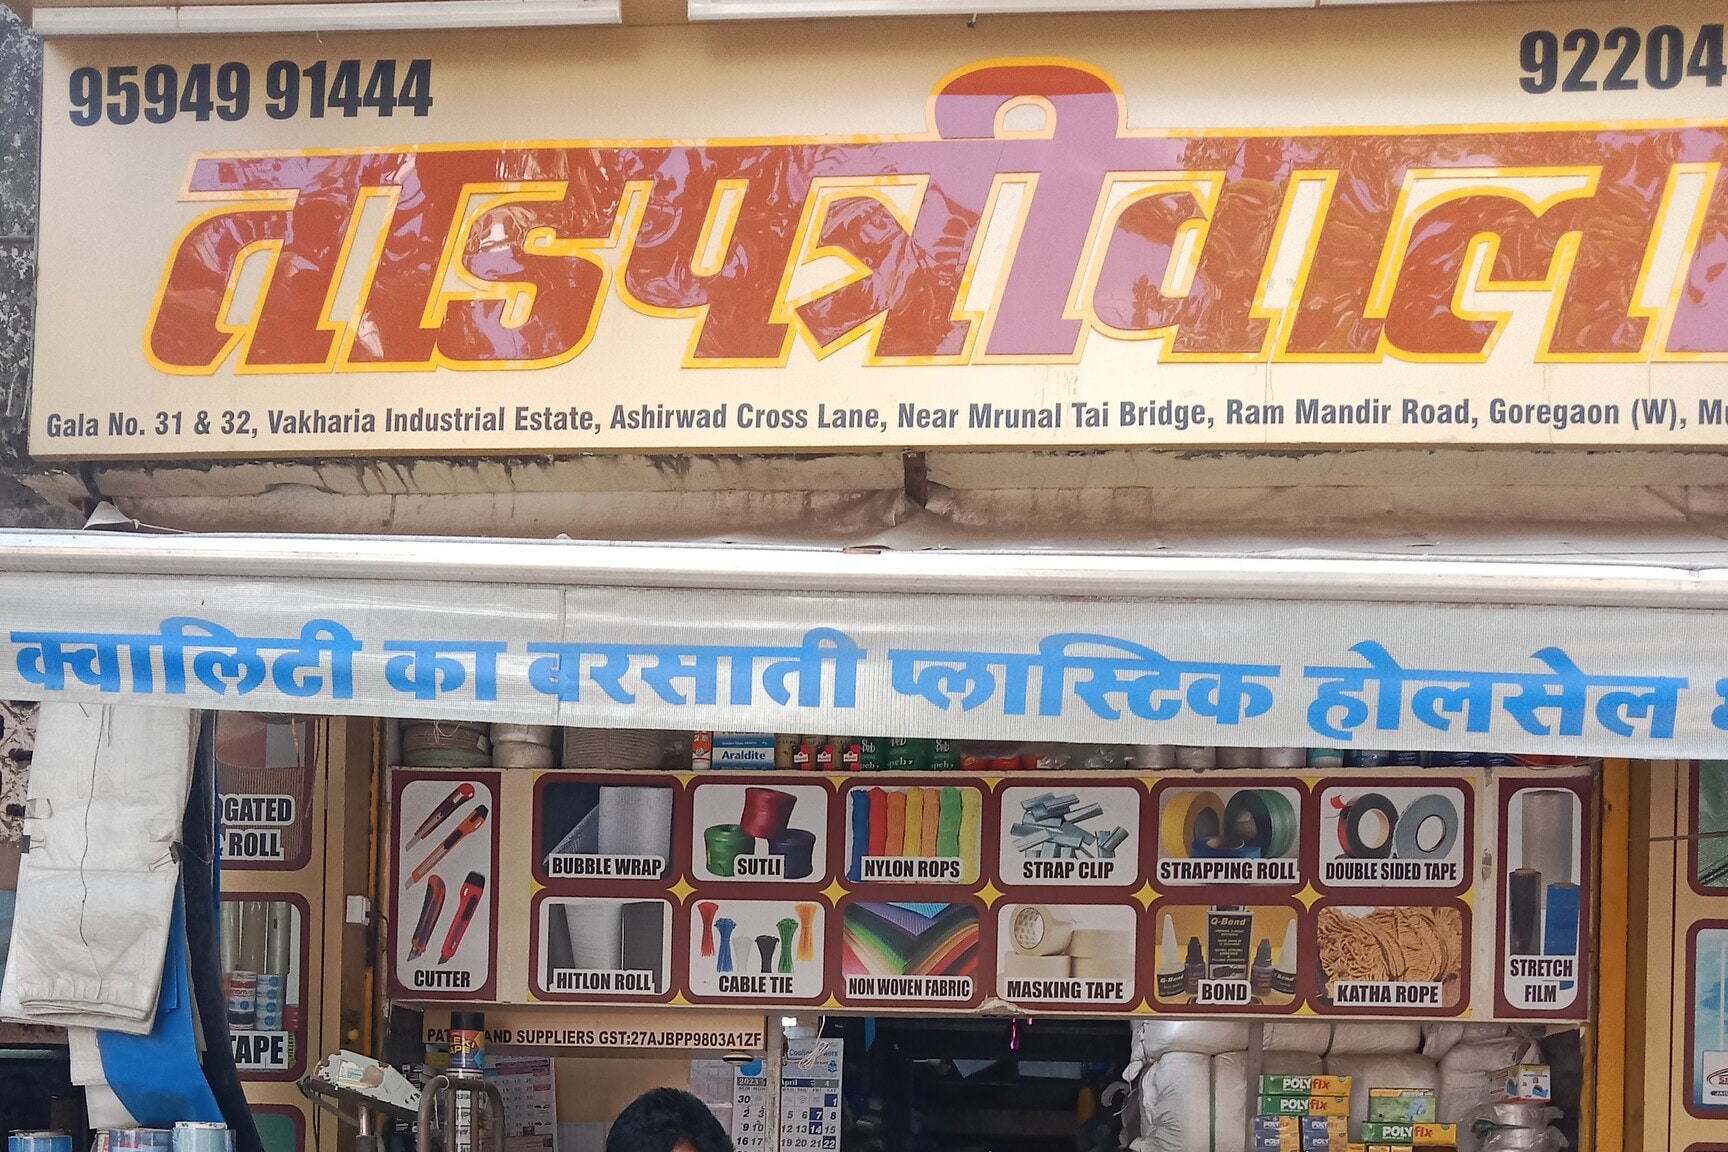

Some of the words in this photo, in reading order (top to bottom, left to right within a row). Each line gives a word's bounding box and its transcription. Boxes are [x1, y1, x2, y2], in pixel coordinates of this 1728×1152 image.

[1518, 24, 1728, 94] 92204
[69, 61, 250, 126] 95949
[265, 58, 434, 119] 91444
[47, 413, 99, 438] Gala
[109, 412, 145, 437] No.
[155, 411, 182, 436] 31
[194, 411, 211, 436] &
[221, 410, 258, 440] 32,
[268, 409, 375, 434] Vakharia
[386, 407, 505, 432] Industrial
[515, 406, 601, 434] Estate,
[610, 404, 726, 430] Ashirwad
[737, 403, 808, 429] Cross
[817, 402, 887, 433] Lane,
[899, 403, 959, 428] Near
[968, 402, 1062, 428] Mrunal
[1072, 401, 1108, 427] Tai
[1119, 400, 1214, 431] Bridge,
[1226, 400, 1284, 425] Ram
[1295, 399, 1391, 425] Mandir
[1401, 399, 1479, 428] Road,
[1490, 399, 1619, 429] Goregaon
[1631, 399, 1687, 429] (W),
[10, 617, 362, 701] क्वालिटी
[383, 640, 509, 702] का
[888, 632, 1281, 727] प्लास्टिक
[1304, 639, 1688, 742] होलसेल
[721, 750, 766, 760] Araldite
[221, 797, 293, 822] GATED
[229, 833, 281, 857] ROLL
[552, 857, 613, 876] BUBBLE
[616, 858, 662, 876] WRAP
[738, 858, 781, 877] SUTLI
[864, 860, 914, 878] NYLON
[918, 860, 960, 879] ROPS
[1023, 861, 1075, 879] STRAP
[1078, 861, 1114, 880] CLIP
[1160, 861, 1253, 880] STRAPPING
[1257, 862, 1296, 880] ROLL
[1325, 862, 1378, 880] DOUBLE
[1381, 862, 1421, 881] SIDED
[1424, 863, 1457, 881] TAPE
[1211, 917, 1247, 926] Q-Bond
[1510, 958, 1573, 978] STRETCH
[414, 970, 471, 988] CUTTER
[556, 972, 611, 990] HITLON
[615, 973, 651, 991] ROLL
[718, 975, 766, 993] CABLE
[770, 976, 793, 993] TIE
[849, 978, 876, 995] NON
[878, 979, 922, 997] WOVEN
[925, 979, 970, 998] FABRIC
[1007, 981, 1083, 999] MASKING
[1086, 982, 1123, 999] TAPE
[1202, 984, 1248, 1001] BOND
[1337, 984, 1393, 1003] KATHA
[1396, 984, 1438, 1004] ROPE
[1524, 984, 1557, 1003] FILM
[427, 1028, 451, 1043] PAT
[484, 1029, 512, 1044] AND
[516, 1029, 595, 1046] SUPPLIERS
[738, 1095, 751, 1104] 30
[787, 1110, 793, 1119] 5
[801, 1110, 808, 1119] 6
[830, 1111, 837, 1120] 8
[743, 1123, 749, 1131] 9
[781, 1124, 792, 1133] 12
[796, 1125, 807, 1133] 13
[810, 1125, 821, 1134] 14
[825, 1125, 836, 1134] 15
[737, 1137, 748, 1145] 16
[751, 1137, 762, 1146] 17
[781, 1138, 792, 1147] 19
[795, 1139, 807, 1147] 20
[823, 1139, 835, 1148] 22
